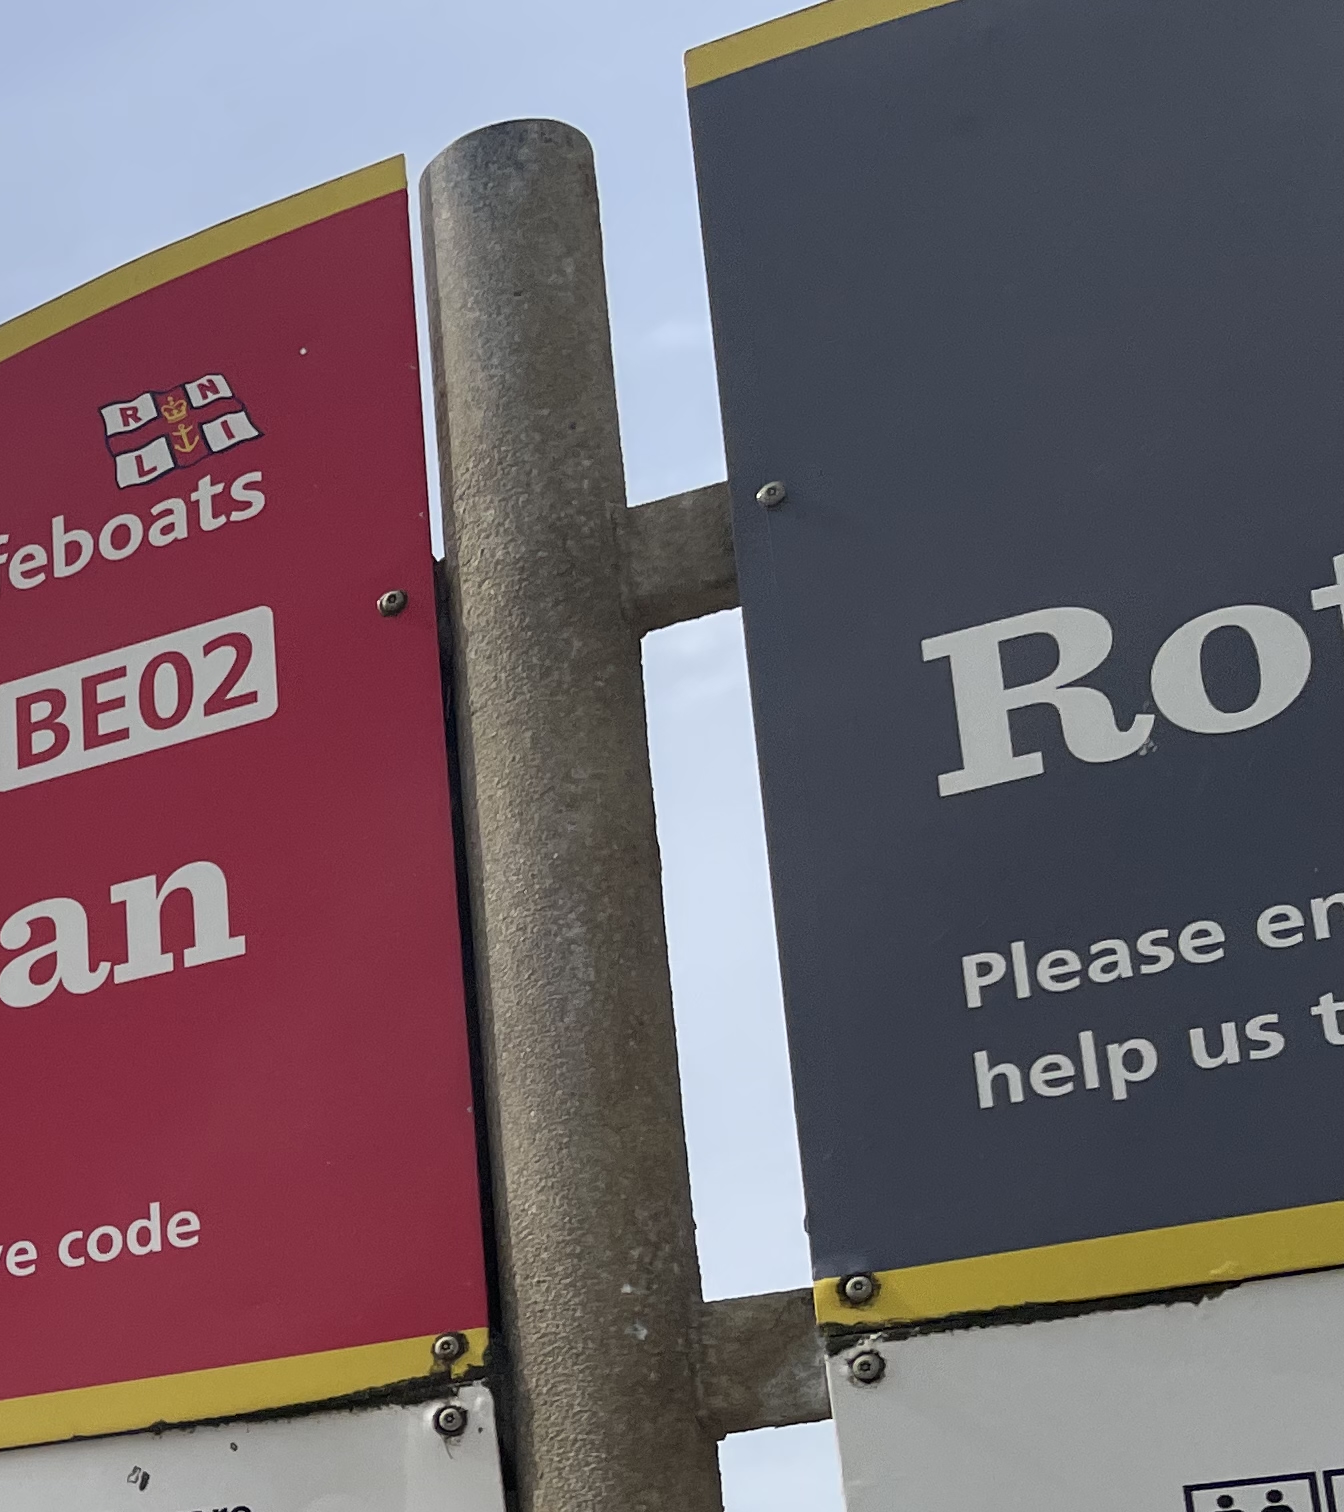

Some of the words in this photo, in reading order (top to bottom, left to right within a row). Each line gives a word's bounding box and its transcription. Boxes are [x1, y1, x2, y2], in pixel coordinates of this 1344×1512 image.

[15, 632, 258, 769] BE02
[963, 921, 1225, 1008] Please
[974, 1030, 1157, 1108] help
[1190, 1014, 1284, 1068] us
[59, 1202, 200, 1267] code
